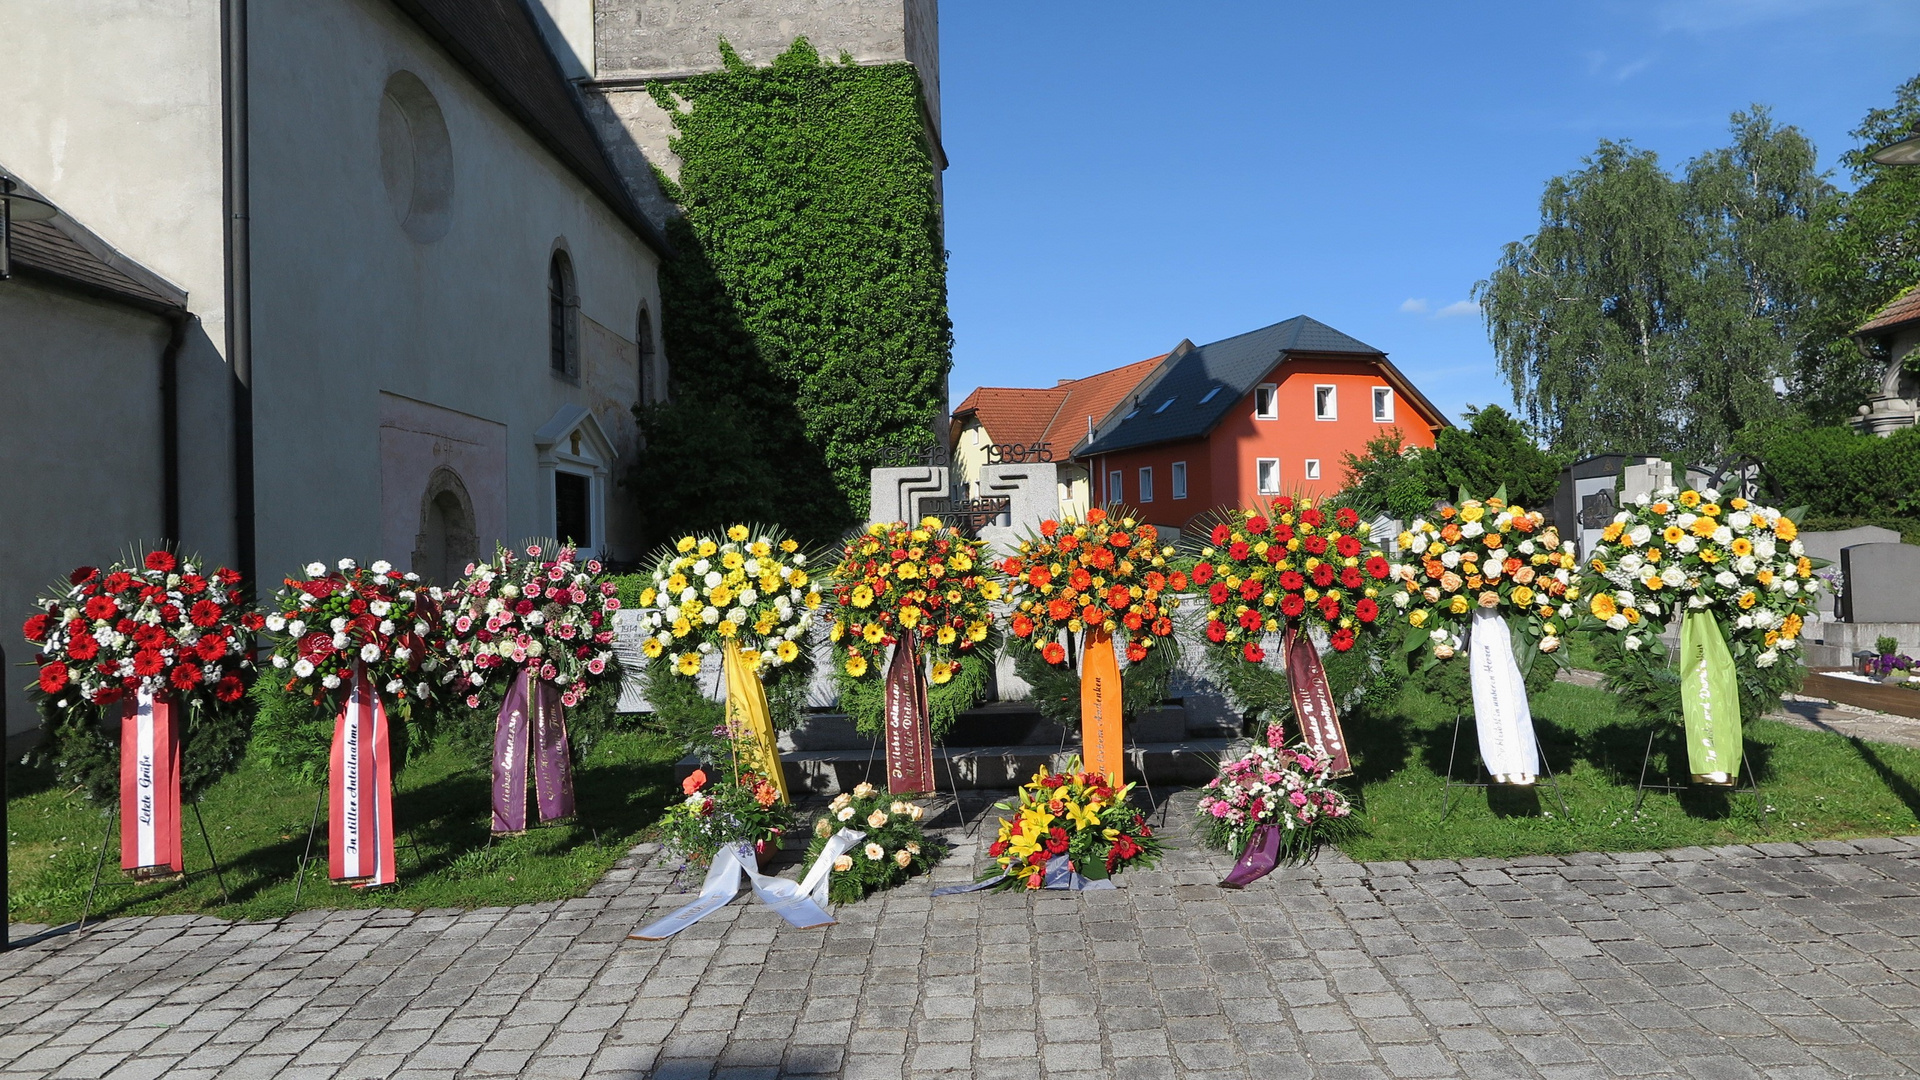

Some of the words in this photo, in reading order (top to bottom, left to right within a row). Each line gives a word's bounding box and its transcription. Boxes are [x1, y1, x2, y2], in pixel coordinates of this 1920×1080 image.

[980, 442, 1053, 465] 1939-45
[929, 499, 1001, 512] UNSEREN
[1483, 645, 1494, 673] Herzen
[1092, 677, 1104, 727] Andenken
[891, 730, 902, 760] lieber
[138, 755, 152, 789] Grüße
[346, 723, 358, 799] Anteilnahme
[892, 761, 903, 779] In
[138, 794, 151, 827] Letzte
[346, 800, 357, 835] stiller
[346, 837, 357, 855] In
